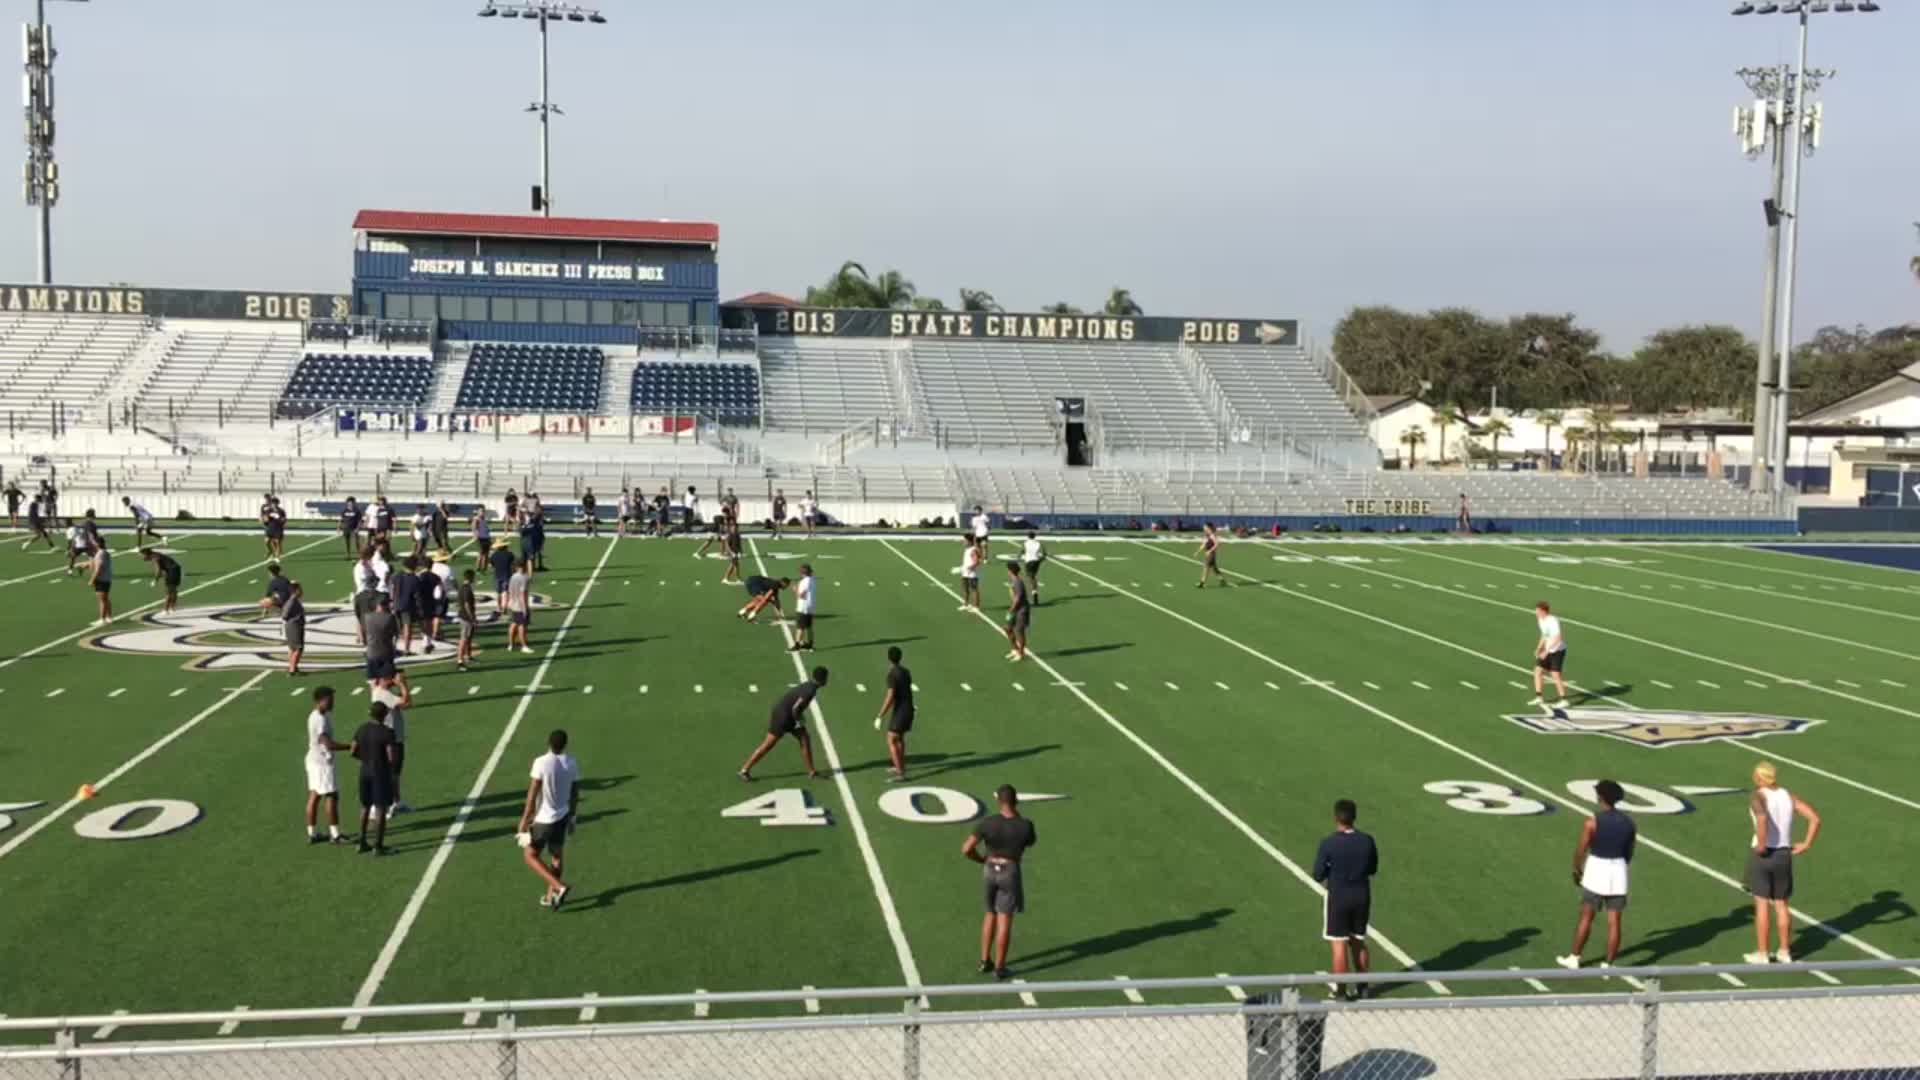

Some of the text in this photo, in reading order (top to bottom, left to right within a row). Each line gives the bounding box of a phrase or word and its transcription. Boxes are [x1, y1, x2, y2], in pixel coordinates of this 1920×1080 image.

[409, 258, 664, 281] JOSEPH M. SANCHEZ III PRESS BOX
[245, 295, 311, 317] 2016
[776, 312, 1240, 342] 2013 STATE CHAMPIONS 2016
[1344, 499, 1431, 515] THE TRIBE
